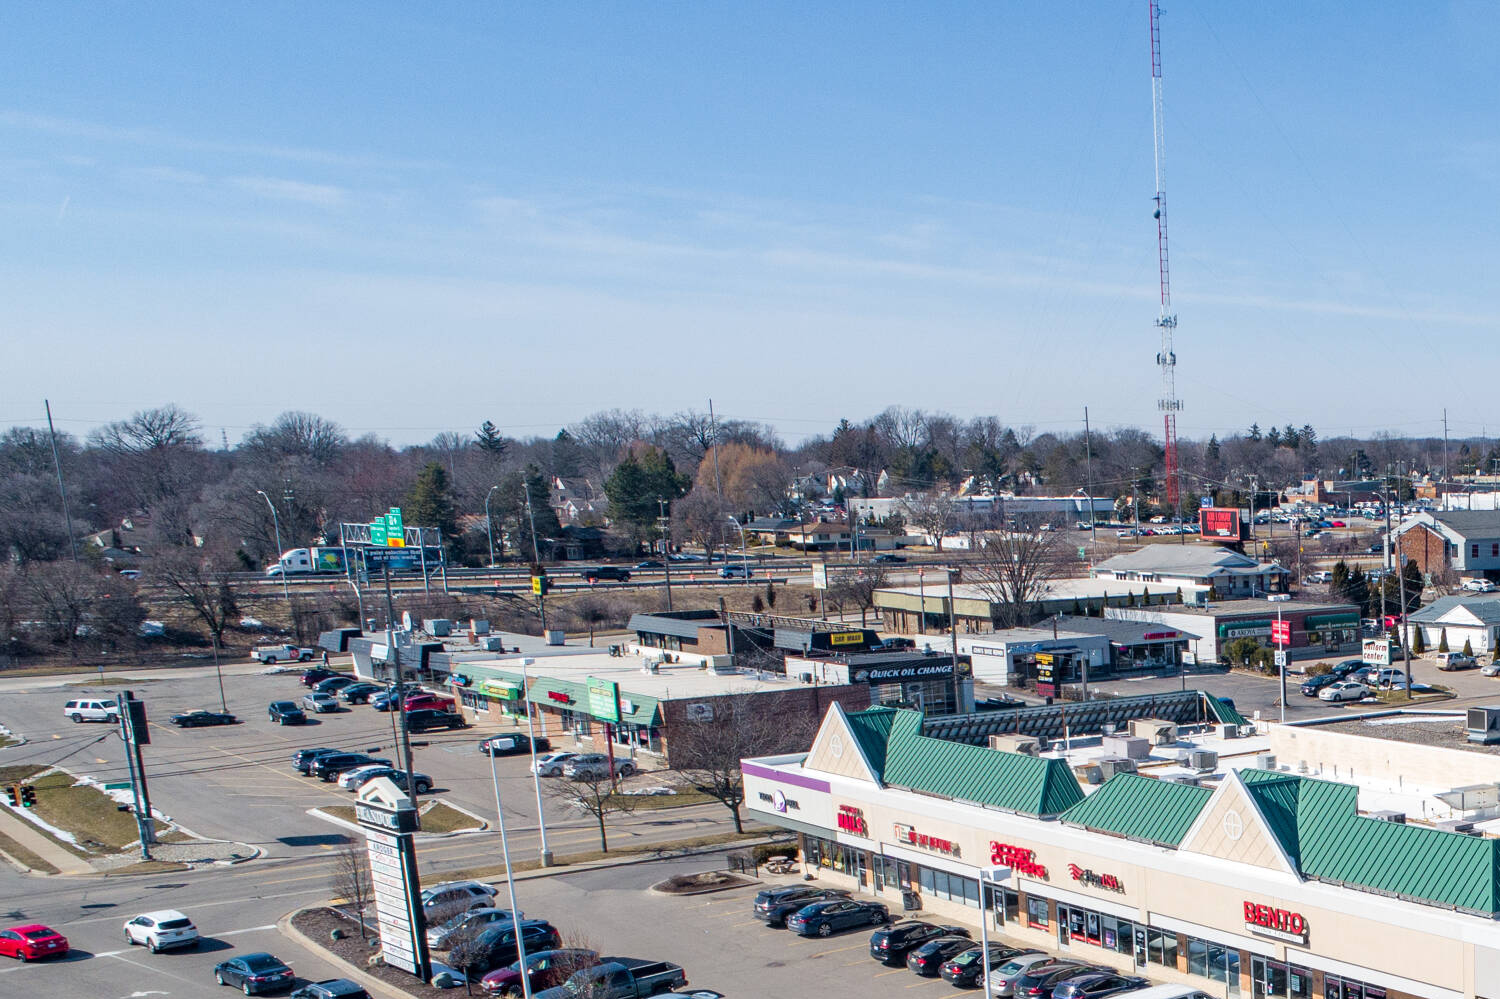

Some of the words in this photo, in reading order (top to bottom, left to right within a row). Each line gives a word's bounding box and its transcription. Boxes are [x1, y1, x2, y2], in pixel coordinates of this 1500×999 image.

[869, 669, 900, 678] QUICK
[901, 668, 917, 676] OIL
[918, 665, 953, 674] CHANGE
[837, 812, 864, 833] NAILS
[997, 843, 1032, 860] COST
[991, 853, 1046, 878] CUTTERS
[1243, 900, 1304, 935] BENTO
